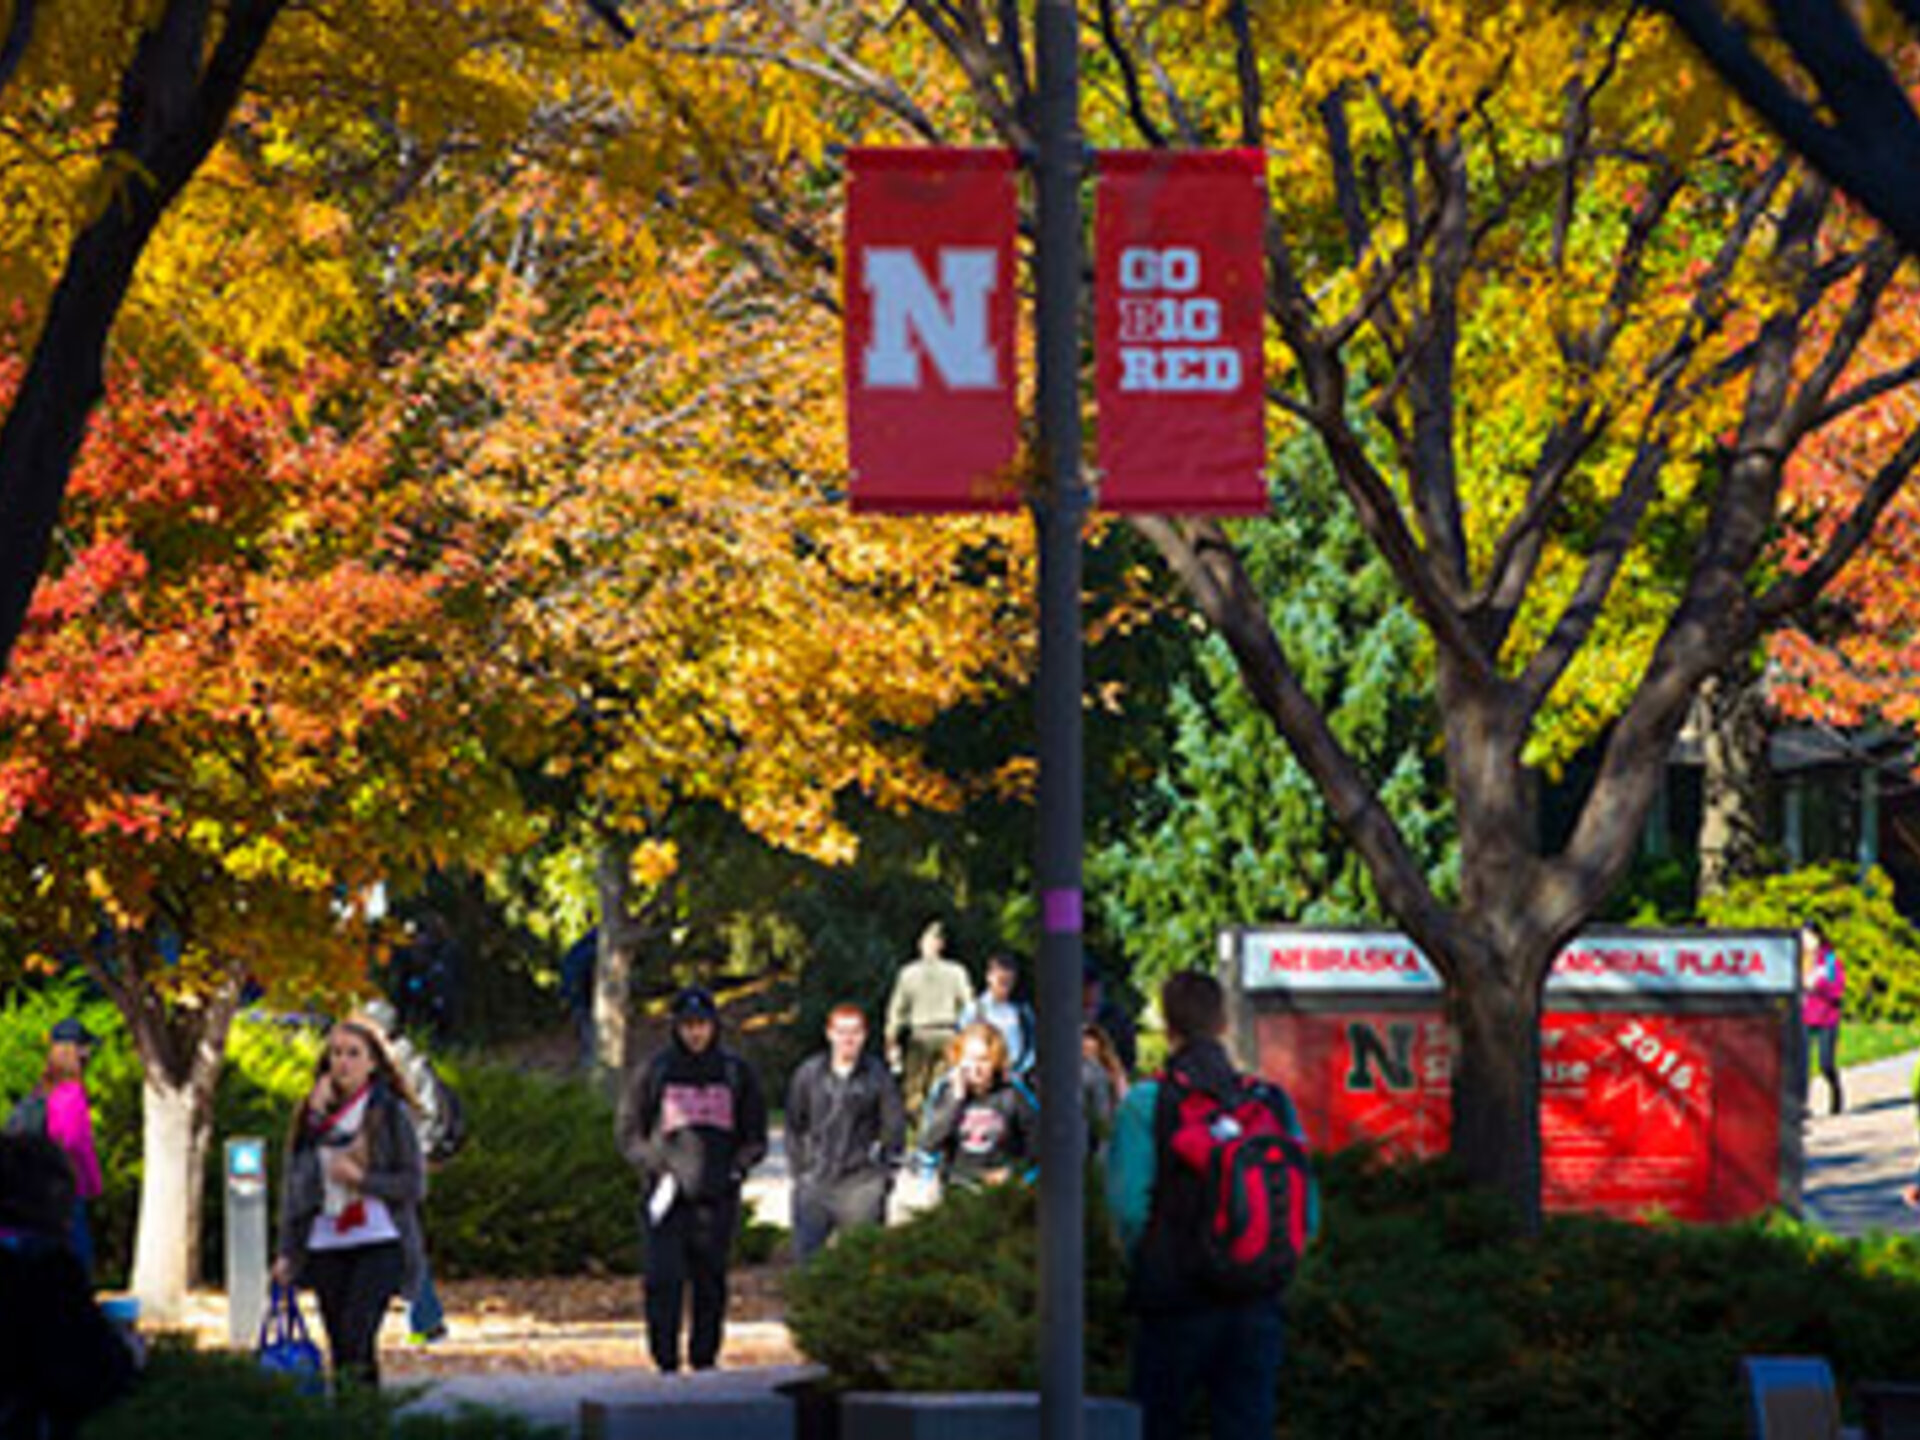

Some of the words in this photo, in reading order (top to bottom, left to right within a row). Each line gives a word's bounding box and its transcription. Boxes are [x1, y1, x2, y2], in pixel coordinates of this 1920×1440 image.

[1119, 247, 1198, 291] GO
[863, 247, 998, 389] N
[1119, 298, 1220, 340] BIG
[1119, 347, 1242, 390] RED
[1269, 948, 1420, 973] NEBRASKA
[1676, 949, 1766, 976] PLAZA
[1346, 1020, 1416, 1092] N
